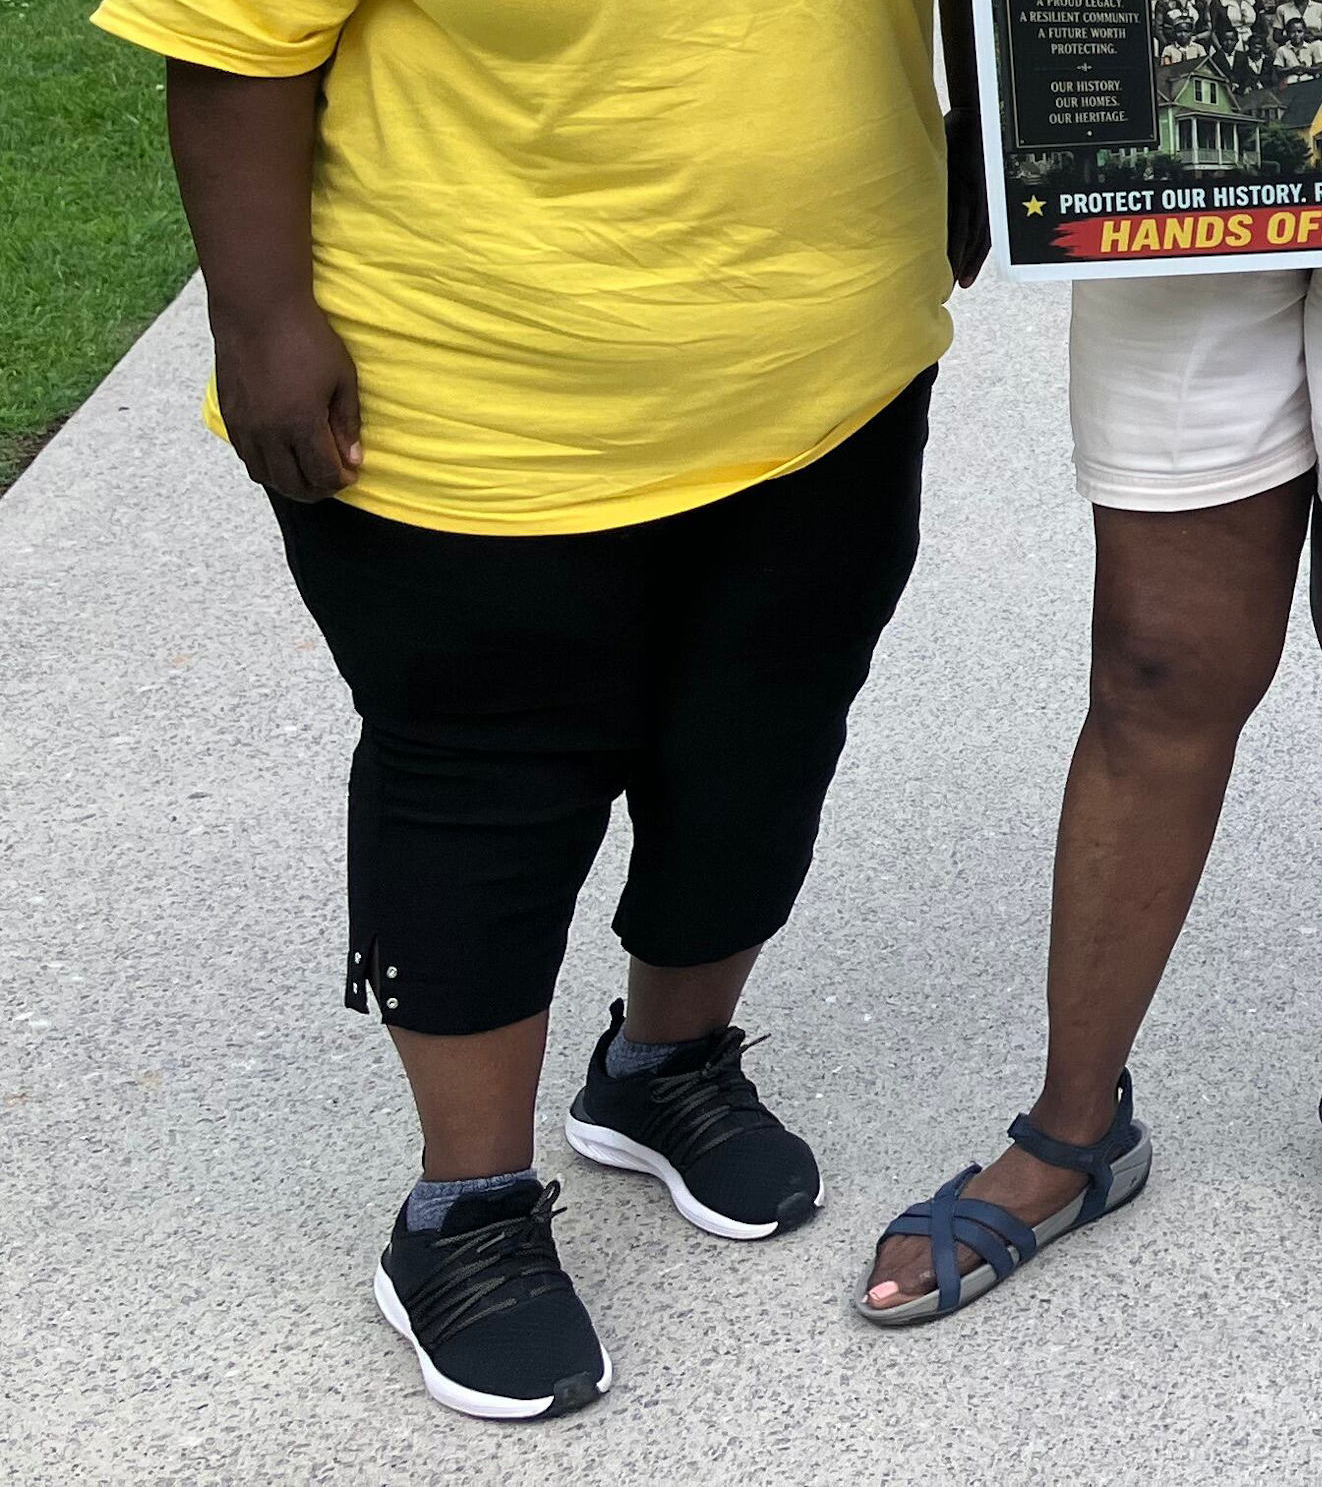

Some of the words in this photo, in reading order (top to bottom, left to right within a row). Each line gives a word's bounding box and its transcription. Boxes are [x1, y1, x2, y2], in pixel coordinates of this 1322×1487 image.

[1020, 11, 1027, 22] A
[1030, 11, 1080, 22] RESILIENT
[1038, 27, 1046, 38] A
[1048, 27, 1088, 39] FUTURE
[1090, 28, 1126, 39] WORTH
[1051, 81, 1074, 93] OUR
[1055, 97, 1078, 108] OUR
[1049, 113, 1072, 124] OUR
[1059, 190, 1154, 214] PROTECT
[1162, 186, 1206, 209] OUR
[1213, 182, 1308, 206] HISTORY.
[1100, 213, 1252, 253] HANDS
